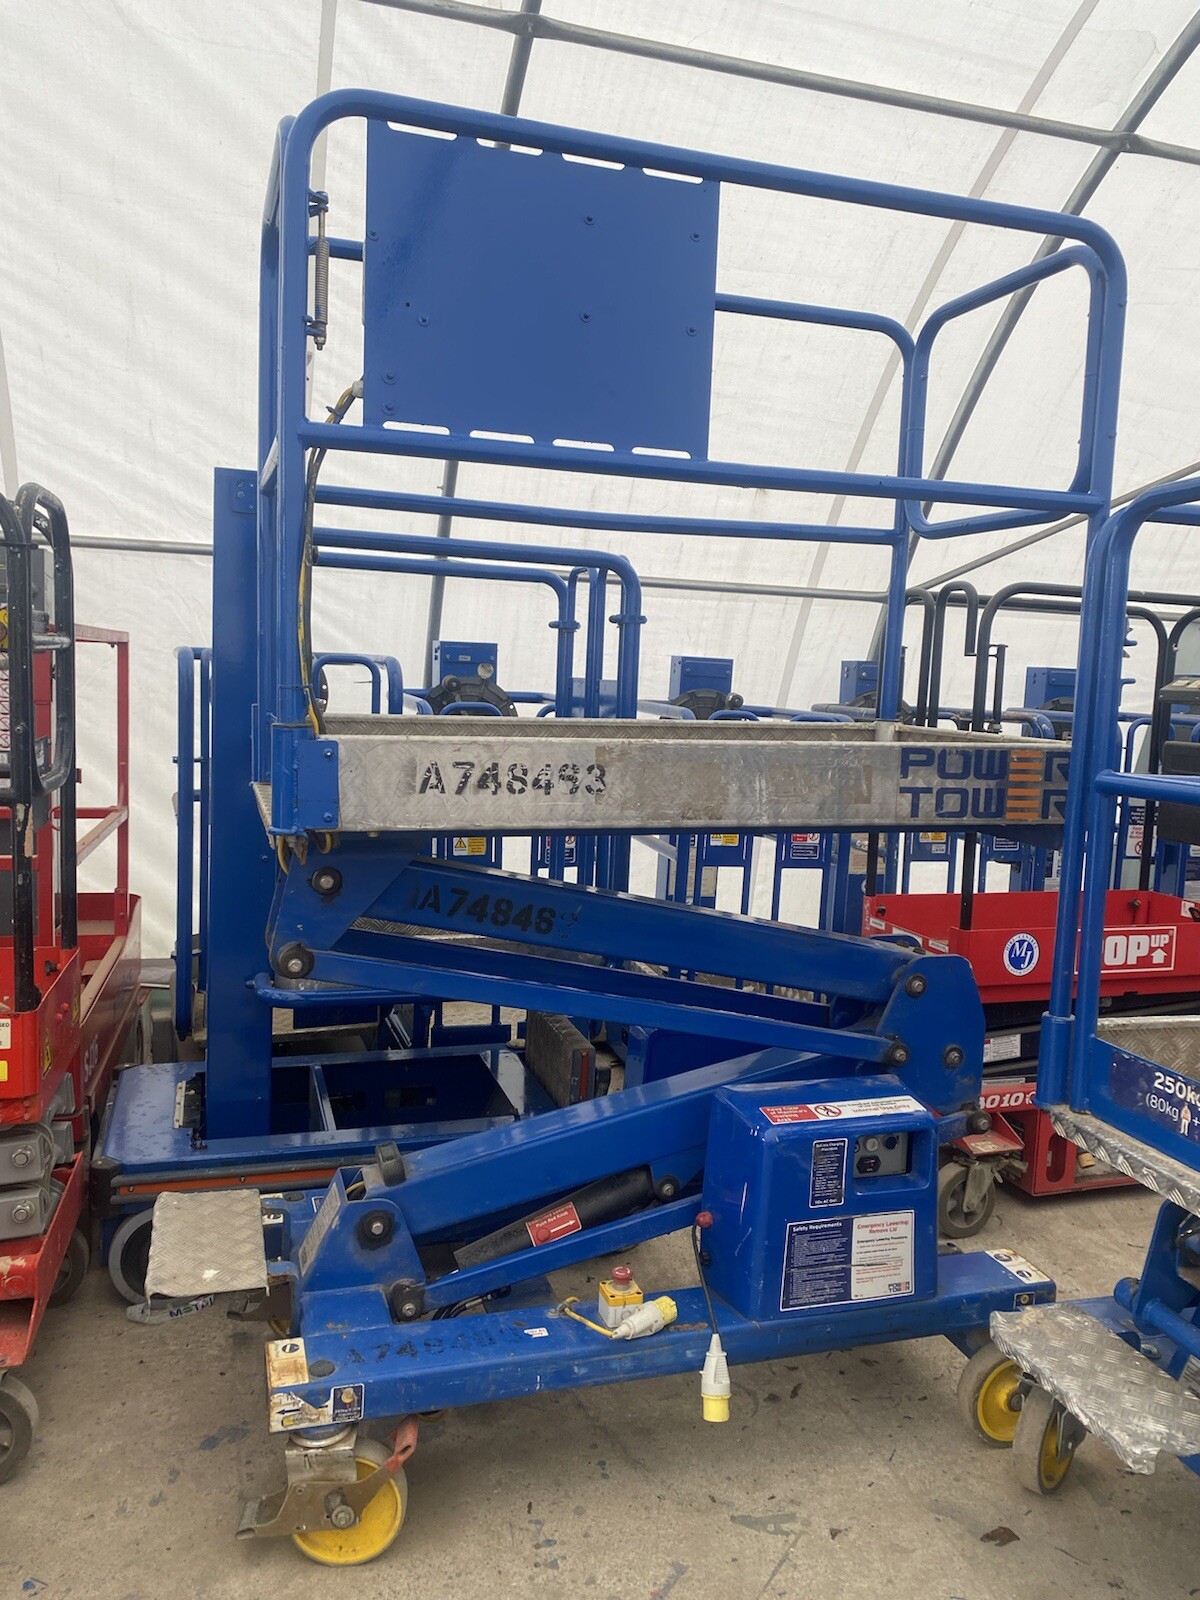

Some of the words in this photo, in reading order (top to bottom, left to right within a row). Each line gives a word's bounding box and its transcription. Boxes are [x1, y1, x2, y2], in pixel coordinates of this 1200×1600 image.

[1151, 934, 1170, 948] UP
[1104, 935, 1150, 967] OP
[793, 1225, 808, 1233] Safety
[809, 1221, 842, 1231] Requirements
